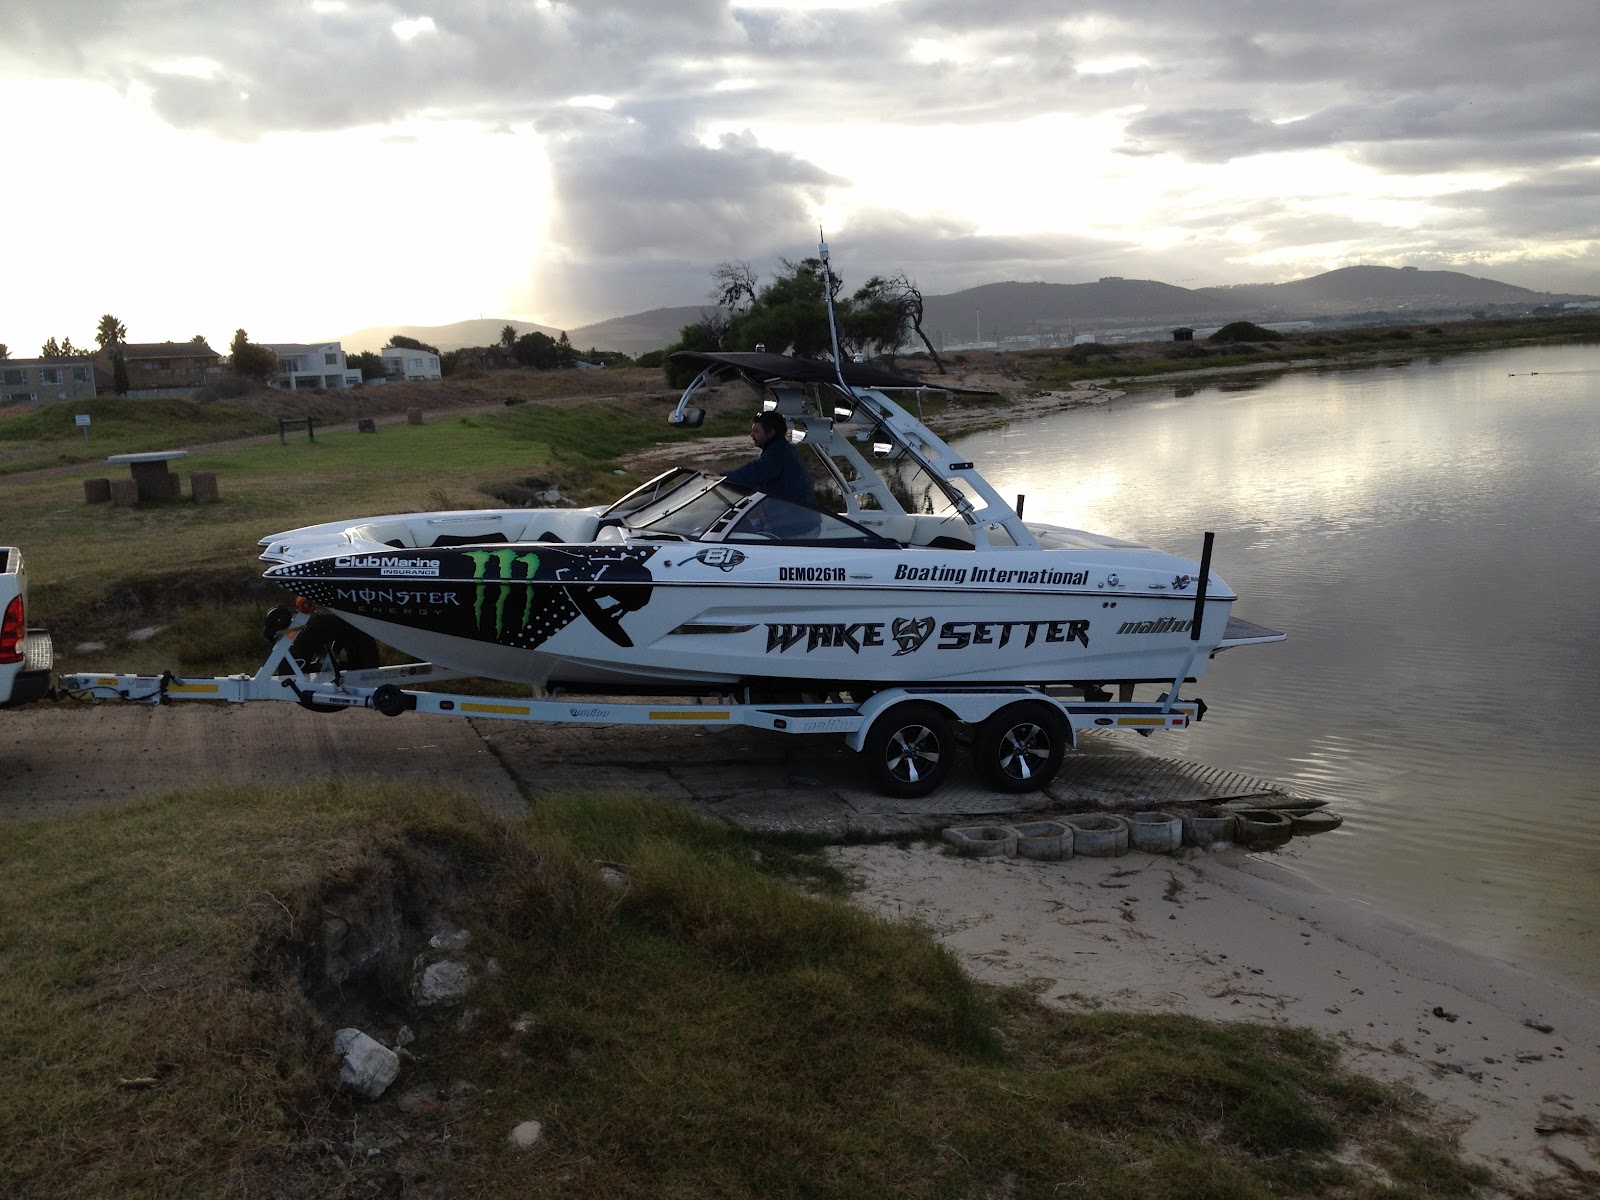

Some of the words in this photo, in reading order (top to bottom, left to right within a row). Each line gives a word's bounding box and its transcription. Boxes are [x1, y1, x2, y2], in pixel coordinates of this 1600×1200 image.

[895, 564, 965, 585] Boating
[970, 566, 1089, 586] International
[358, 606, 442, 615] ENERGY
[1116, 616, 1194, 635] malibu
[764, 622, 886, 654] WAKE
[937, 619, 1091, 649] SETTER
